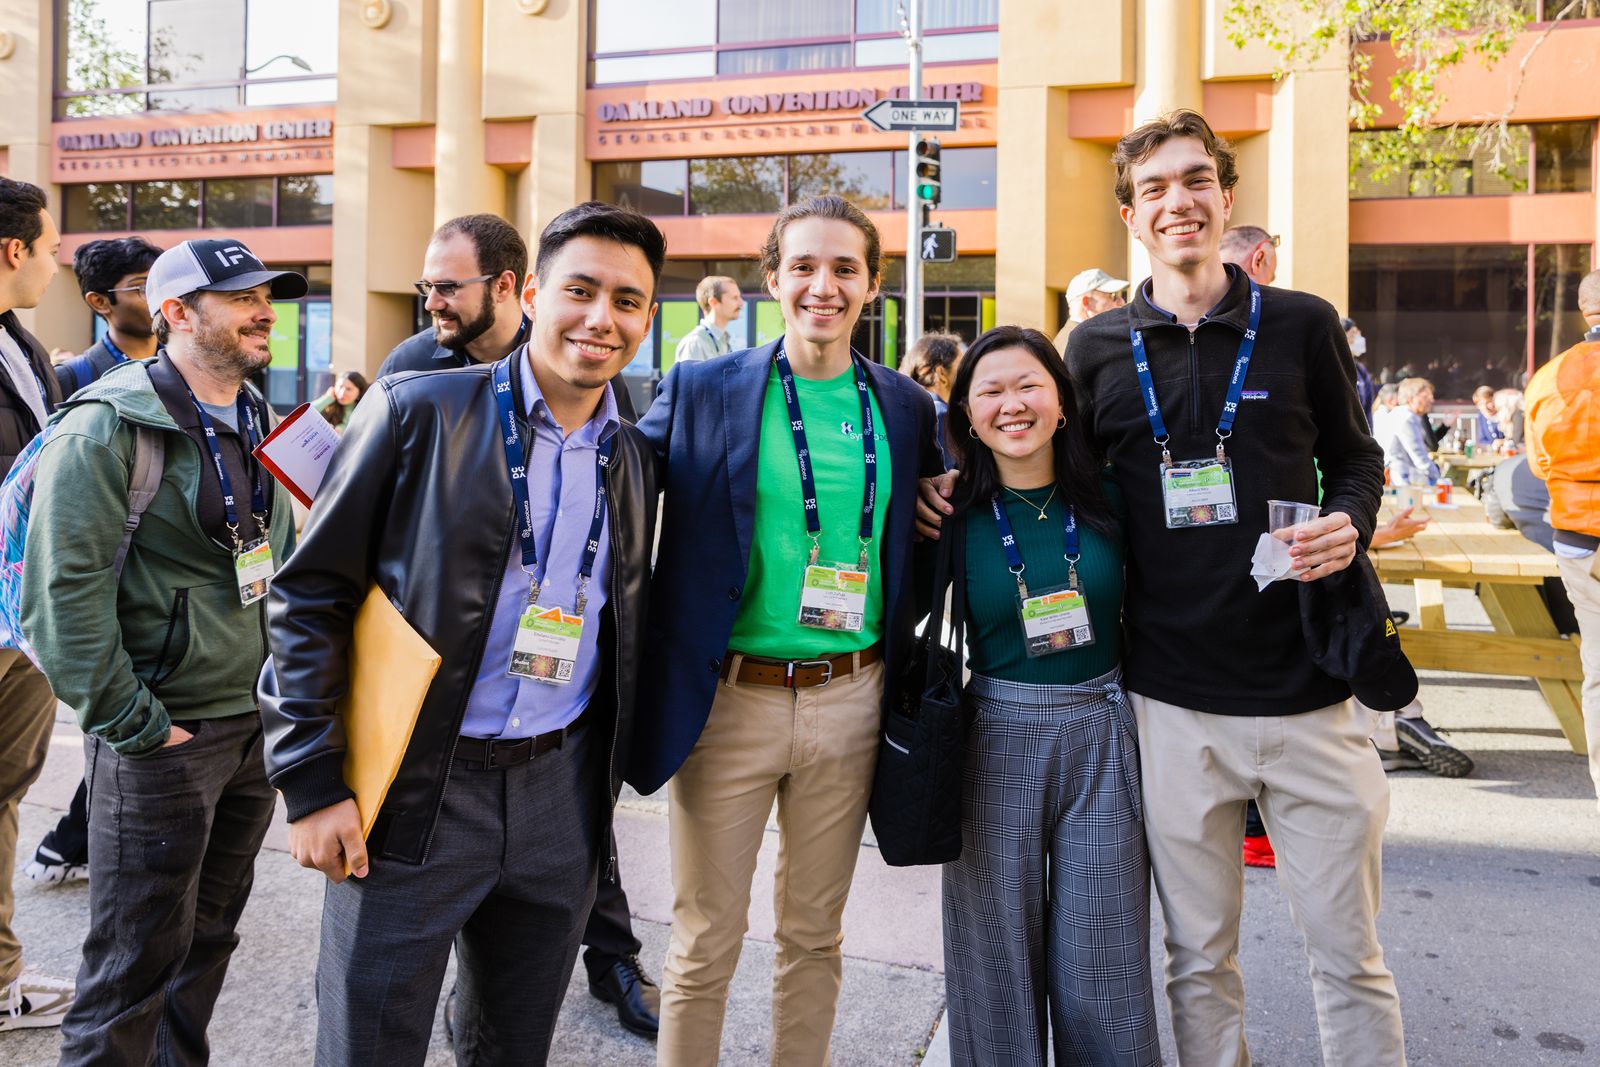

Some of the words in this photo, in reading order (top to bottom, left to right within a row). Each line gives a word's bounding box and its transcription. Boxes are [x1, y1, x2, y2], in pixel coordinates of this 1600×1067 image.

[597, 100, 713, 122] OAKLAND
[719, 88, 878, 115] CONVENTION
[892, 110, 917, 121] ONE
[923, 110, 949, 120] WAY
[58, 132, 142, 151] OAKLAND
[147, 124, 260, 147] CONVENTION
[262, 119, 333, 140] CENTER
[508, 410, 518, 440] synbiobeta
[524, 500, 532, 532] synbiobeta
